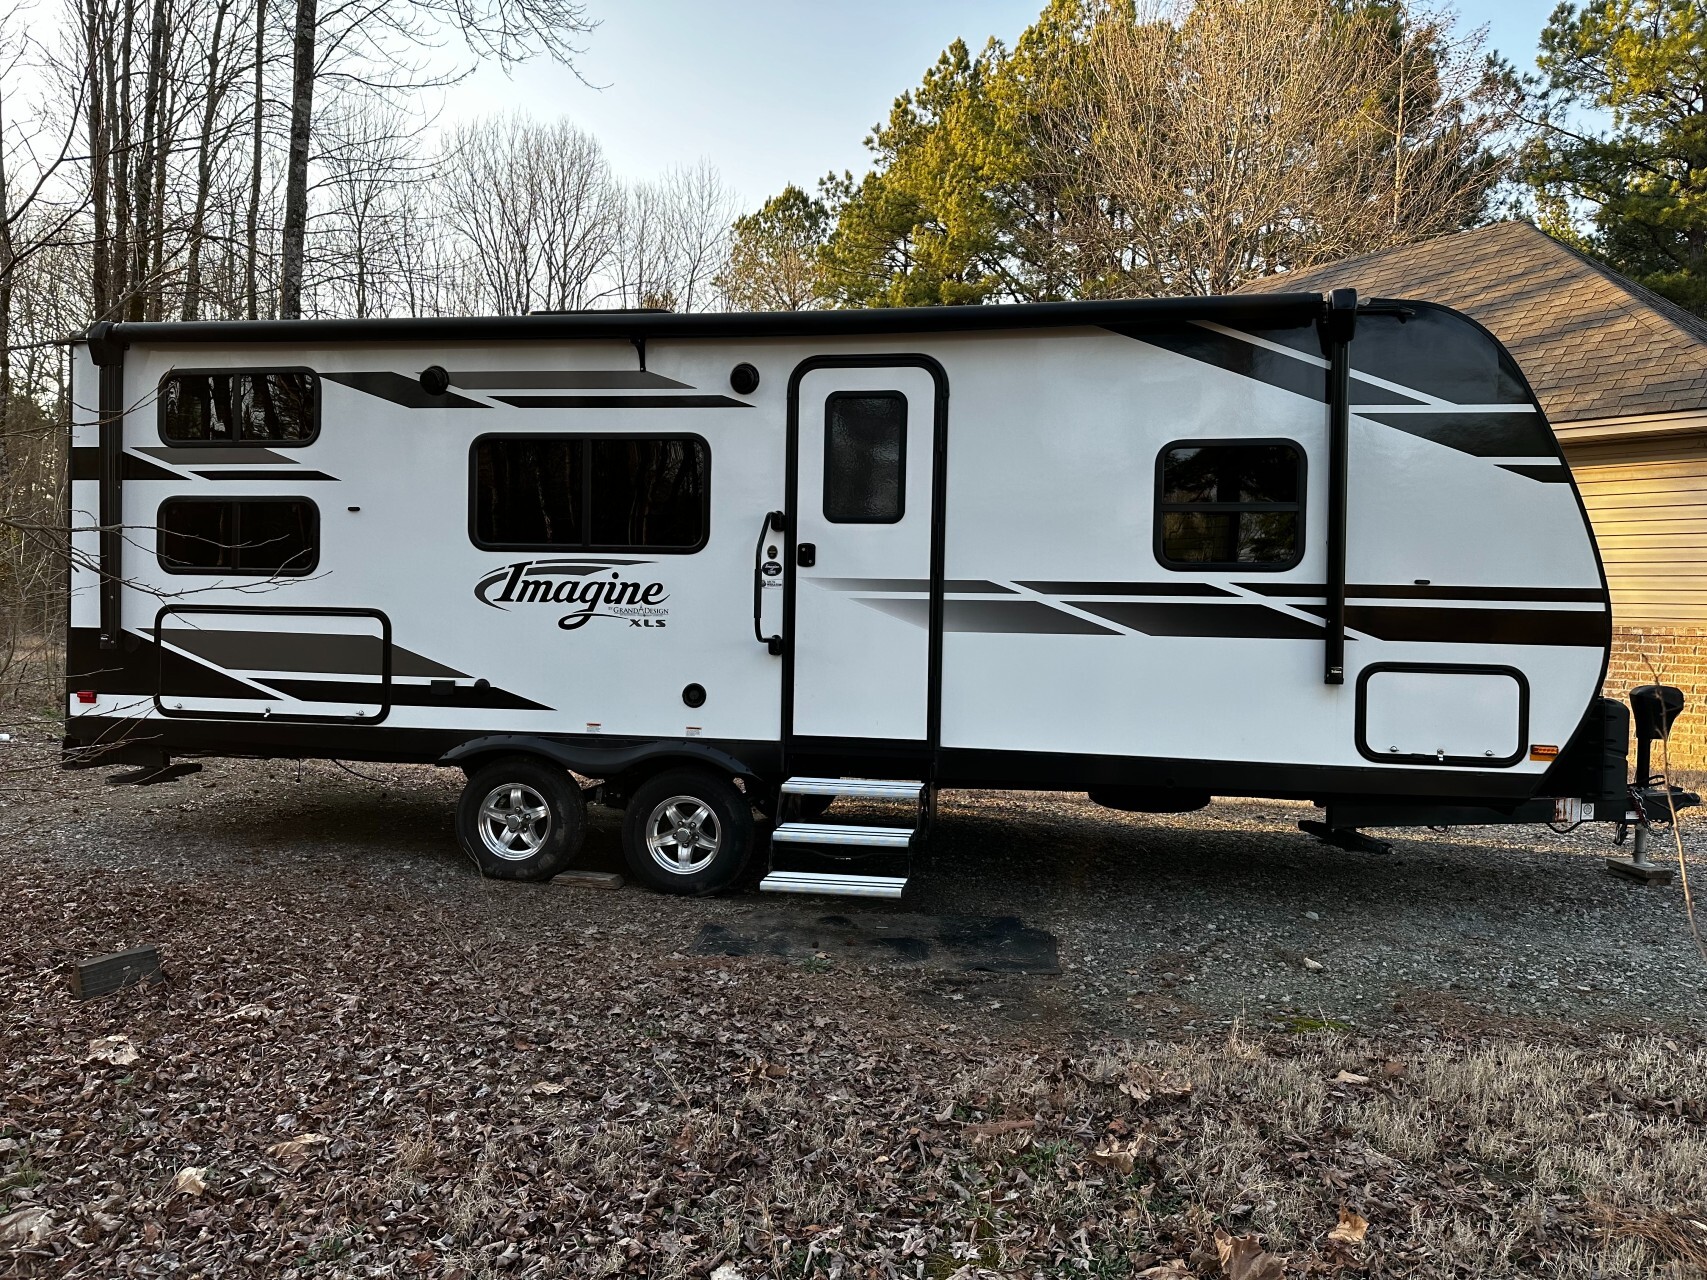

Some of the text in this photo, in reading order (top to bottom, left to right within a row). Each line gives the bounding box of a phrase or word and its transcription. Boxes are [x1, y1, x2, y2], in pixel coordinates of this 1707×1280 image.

[493, 561, 670, 630] Imagine
[613, 606, 639, 614] GRAND
[644, 607, 669, 615] DESIGN
[629, 619, 666, 627] XLS
